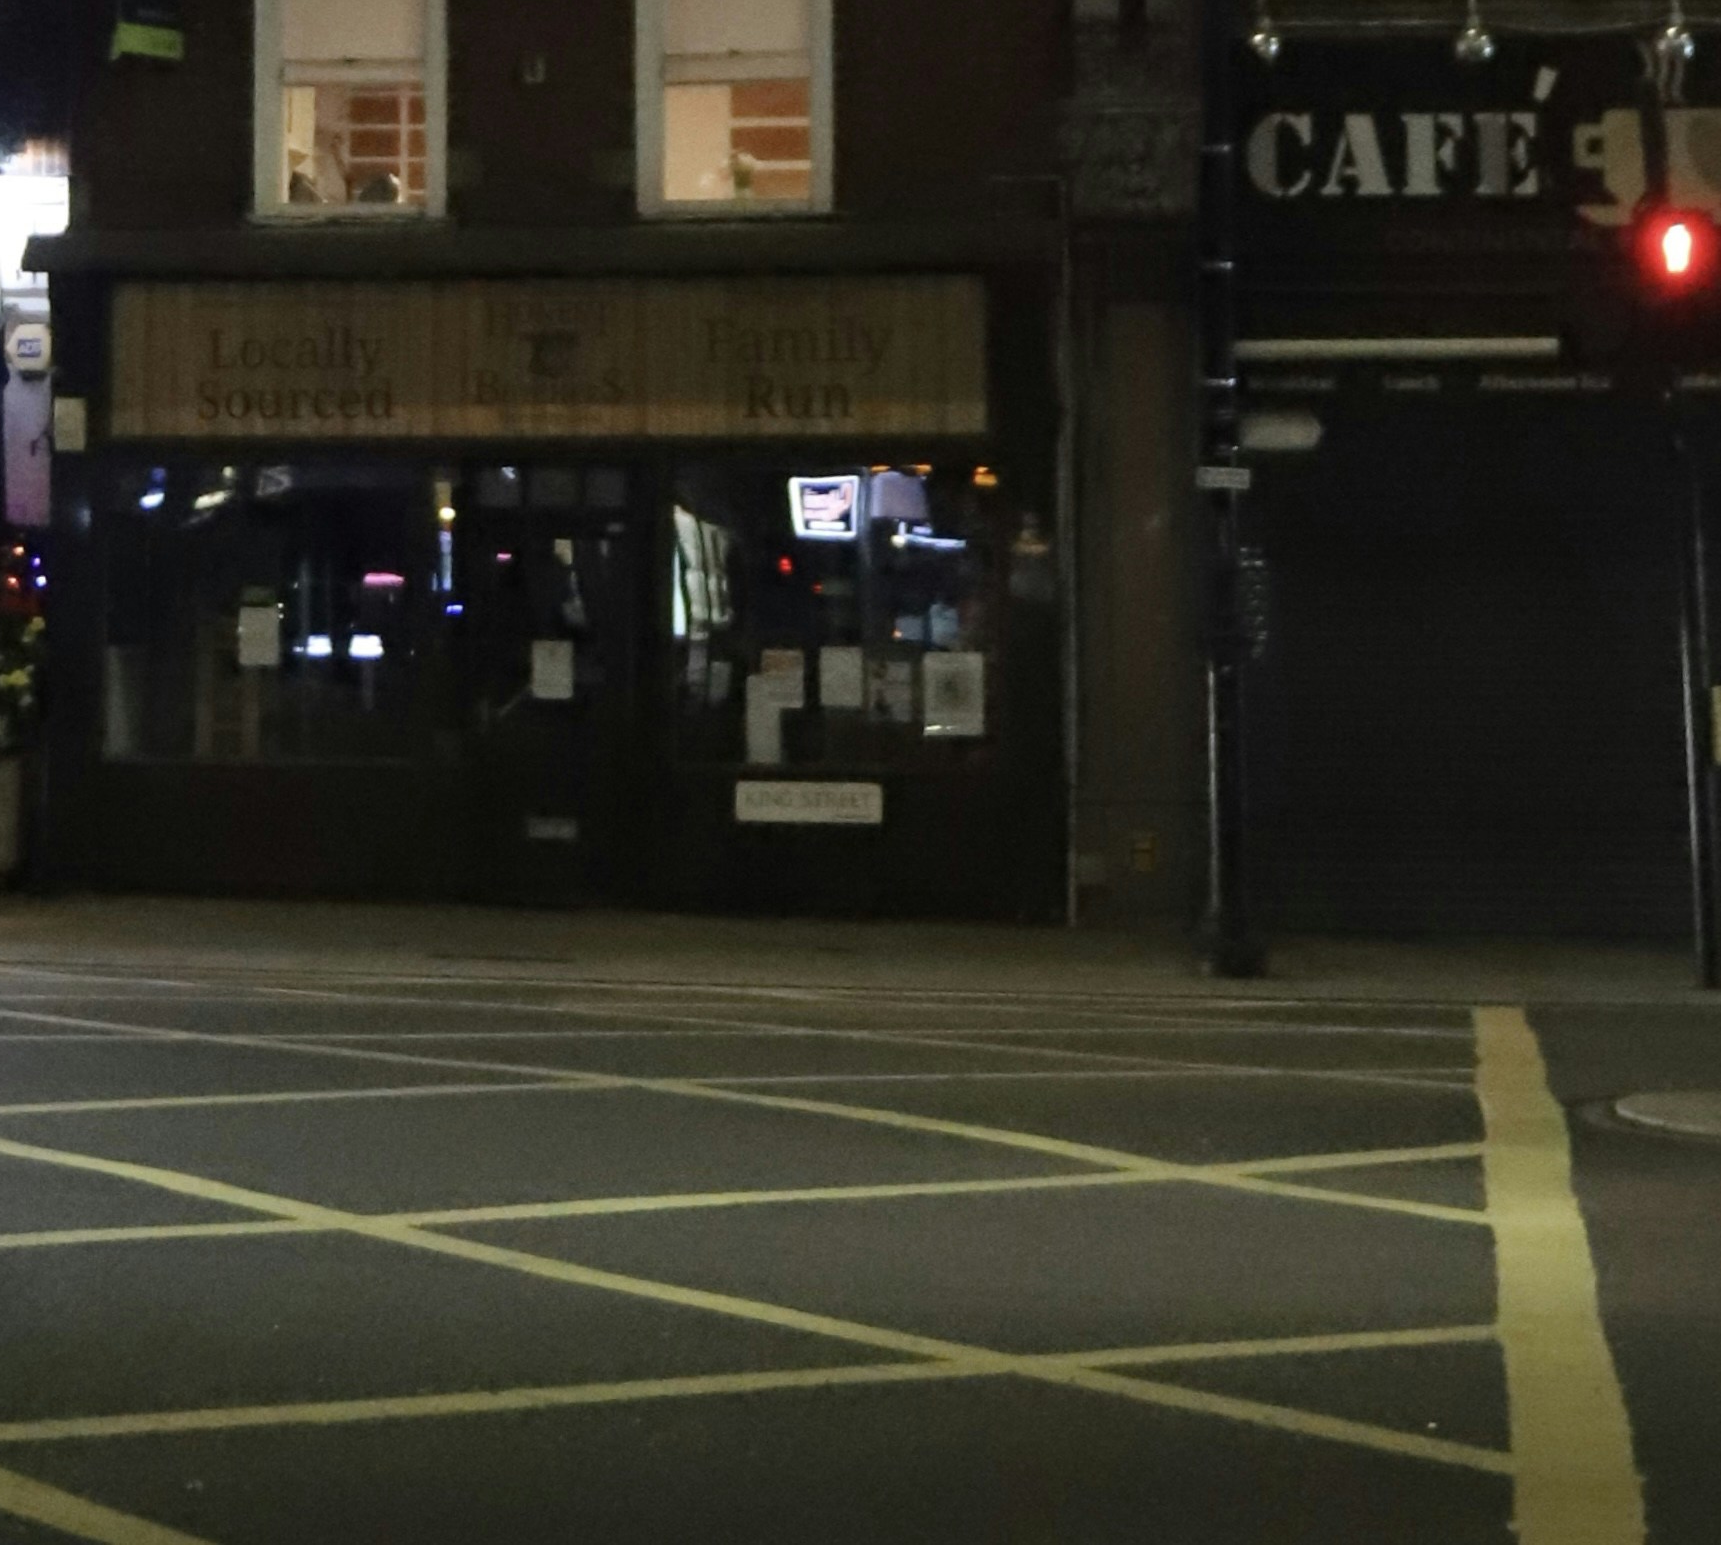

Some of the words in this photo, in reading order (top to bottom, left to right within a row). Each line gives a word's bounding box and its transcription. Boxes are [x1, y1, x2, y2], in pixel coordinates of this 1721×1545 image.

[1246, 67, 1559, 199] CAFÉ
[207, 326, 386, 374] Locally
[701, 314, 895, 376] Family
[195, 375, 392, 421] Sourced
[743, 373, 855, 420] Run
